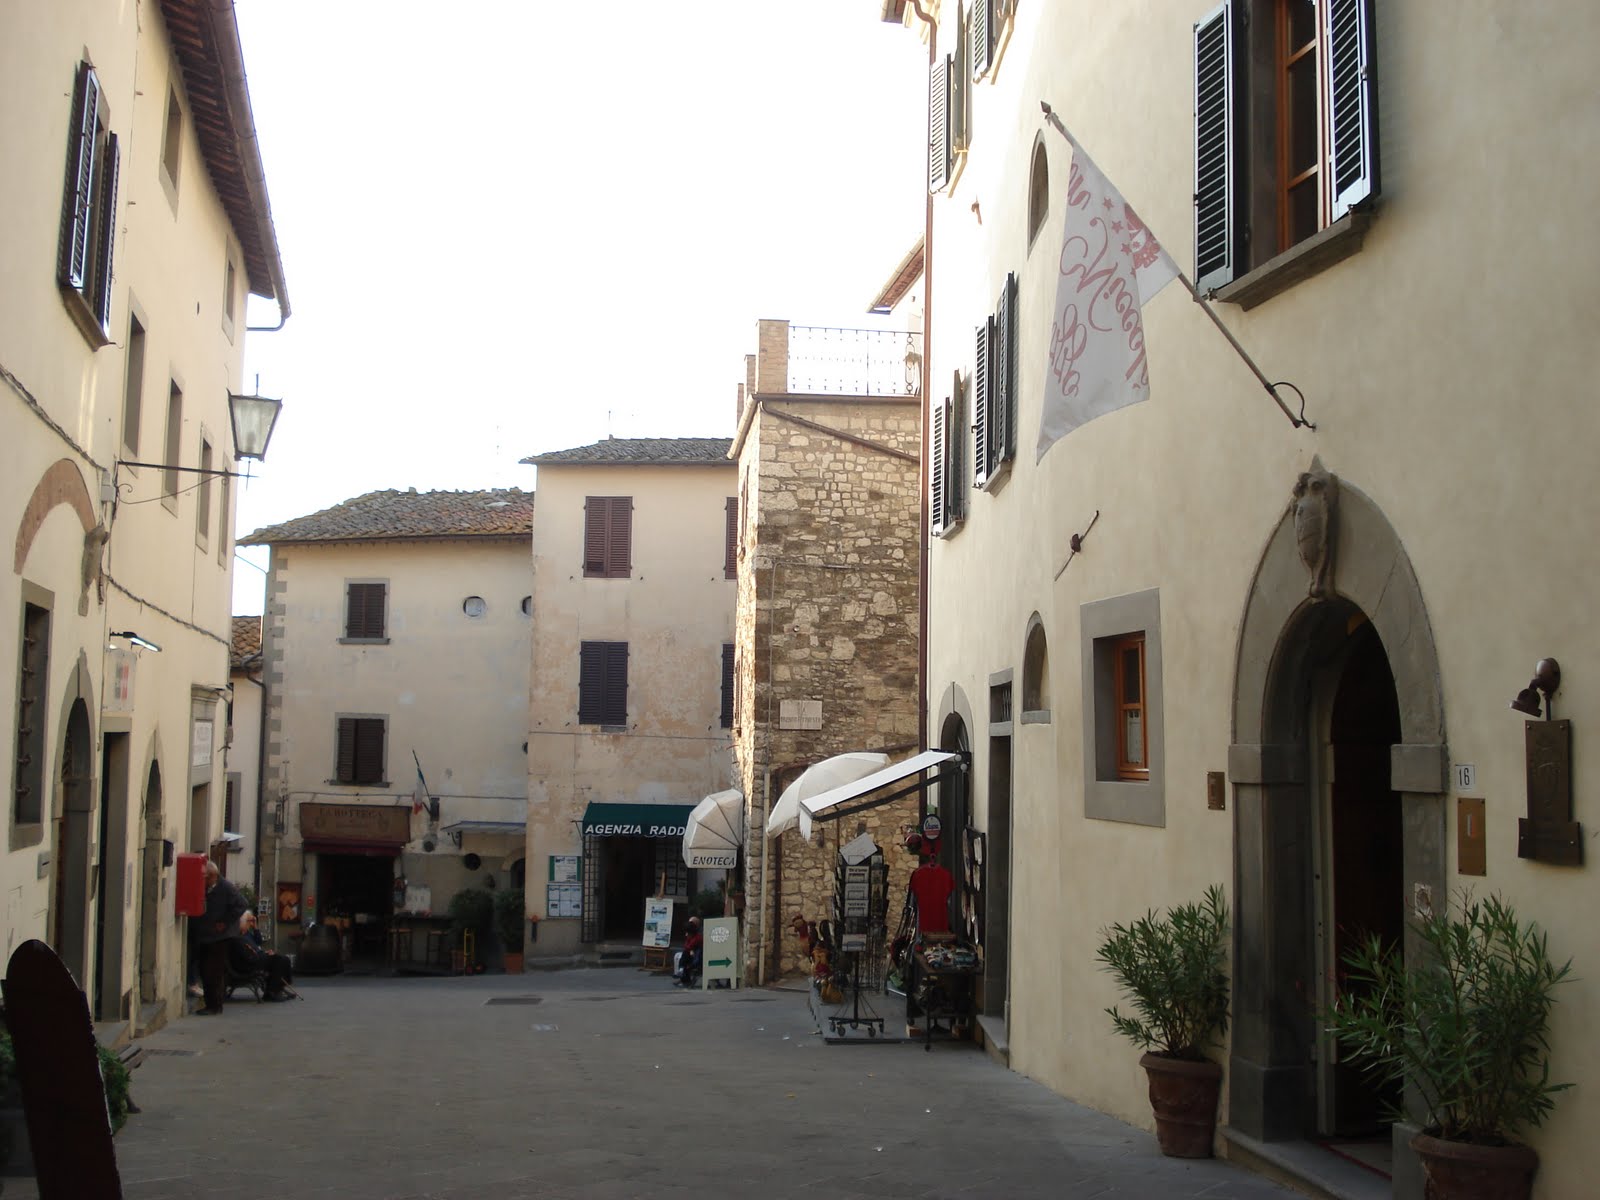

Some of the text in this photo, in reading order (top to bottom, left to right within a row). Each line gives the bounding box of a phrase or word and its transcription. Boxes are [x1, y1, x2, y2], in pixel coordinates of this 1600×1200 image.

[1458, 767, 1470, 786] 16
[585, 824, 686, 836] AGENZIA RADD
[692, 856, 735, 866] ENOTECA
